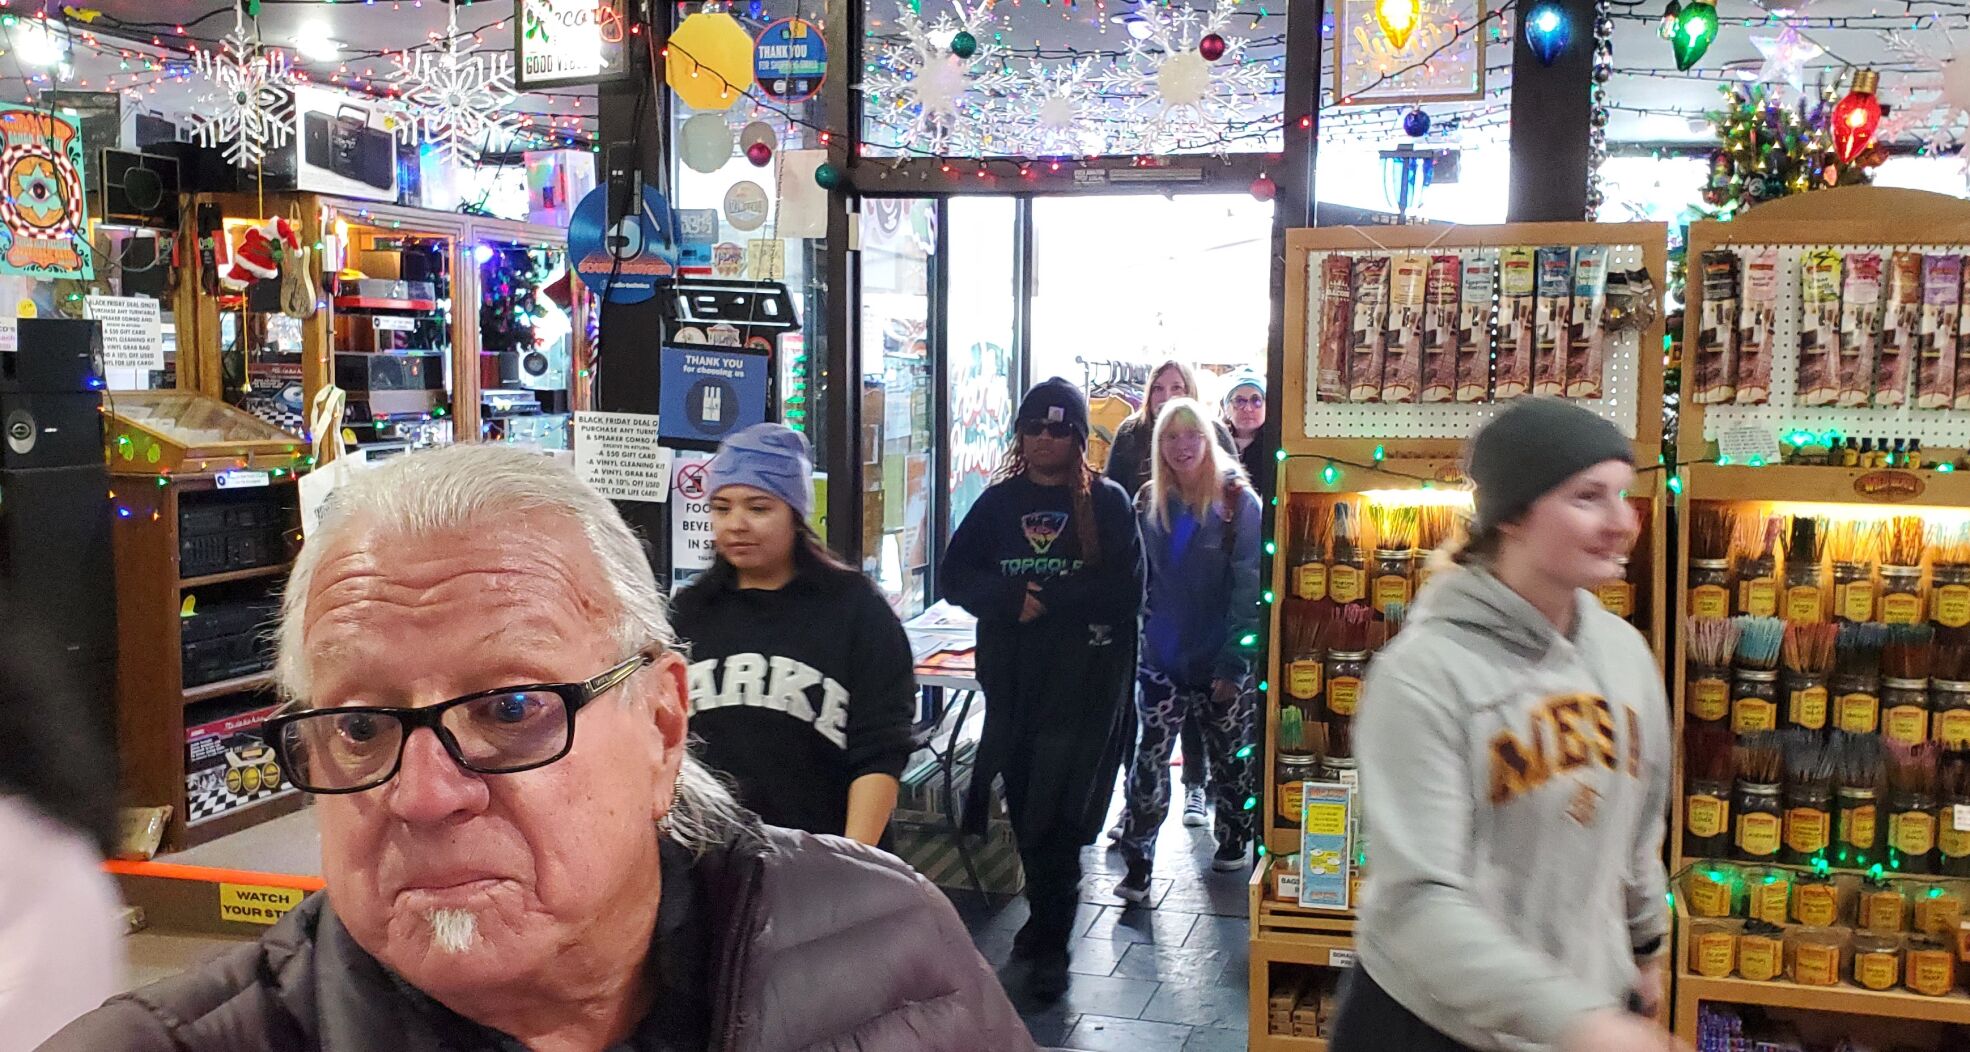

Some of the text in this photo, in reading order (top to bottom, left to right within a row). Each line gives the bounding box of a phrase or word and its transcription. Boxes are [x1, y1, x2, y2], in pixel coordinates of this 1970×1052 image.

[759, 45, 808, 58] THANK YOU
[526, 55, 552, 74] GOOD
[685, 355, 743, 369] THANK YOU
[683, 365, 744, 378] for choosing us
[579, 416, 603, 424] BLACK
[605, 417, 630, 426] FRIDAY
[633, 419, 650, 427] DEAL
[581, 425, 617, 433] PURCHASE
[636, 428, 656, 436] TURNT
[638, 452, 656, 460] CARD
[620, 460, 654, 469] CLEANING
[611, 487, 625, 495] FOR
[627, 488, 639, 496] LIFE
[686, 503, 711, 513] FOO
[688, 539, 699, 549] IN
[688, 652, 850, 750] ARKE
[236, 890, 290, 904] WATCH
[223, 905, 287, 918] YOUR ST
